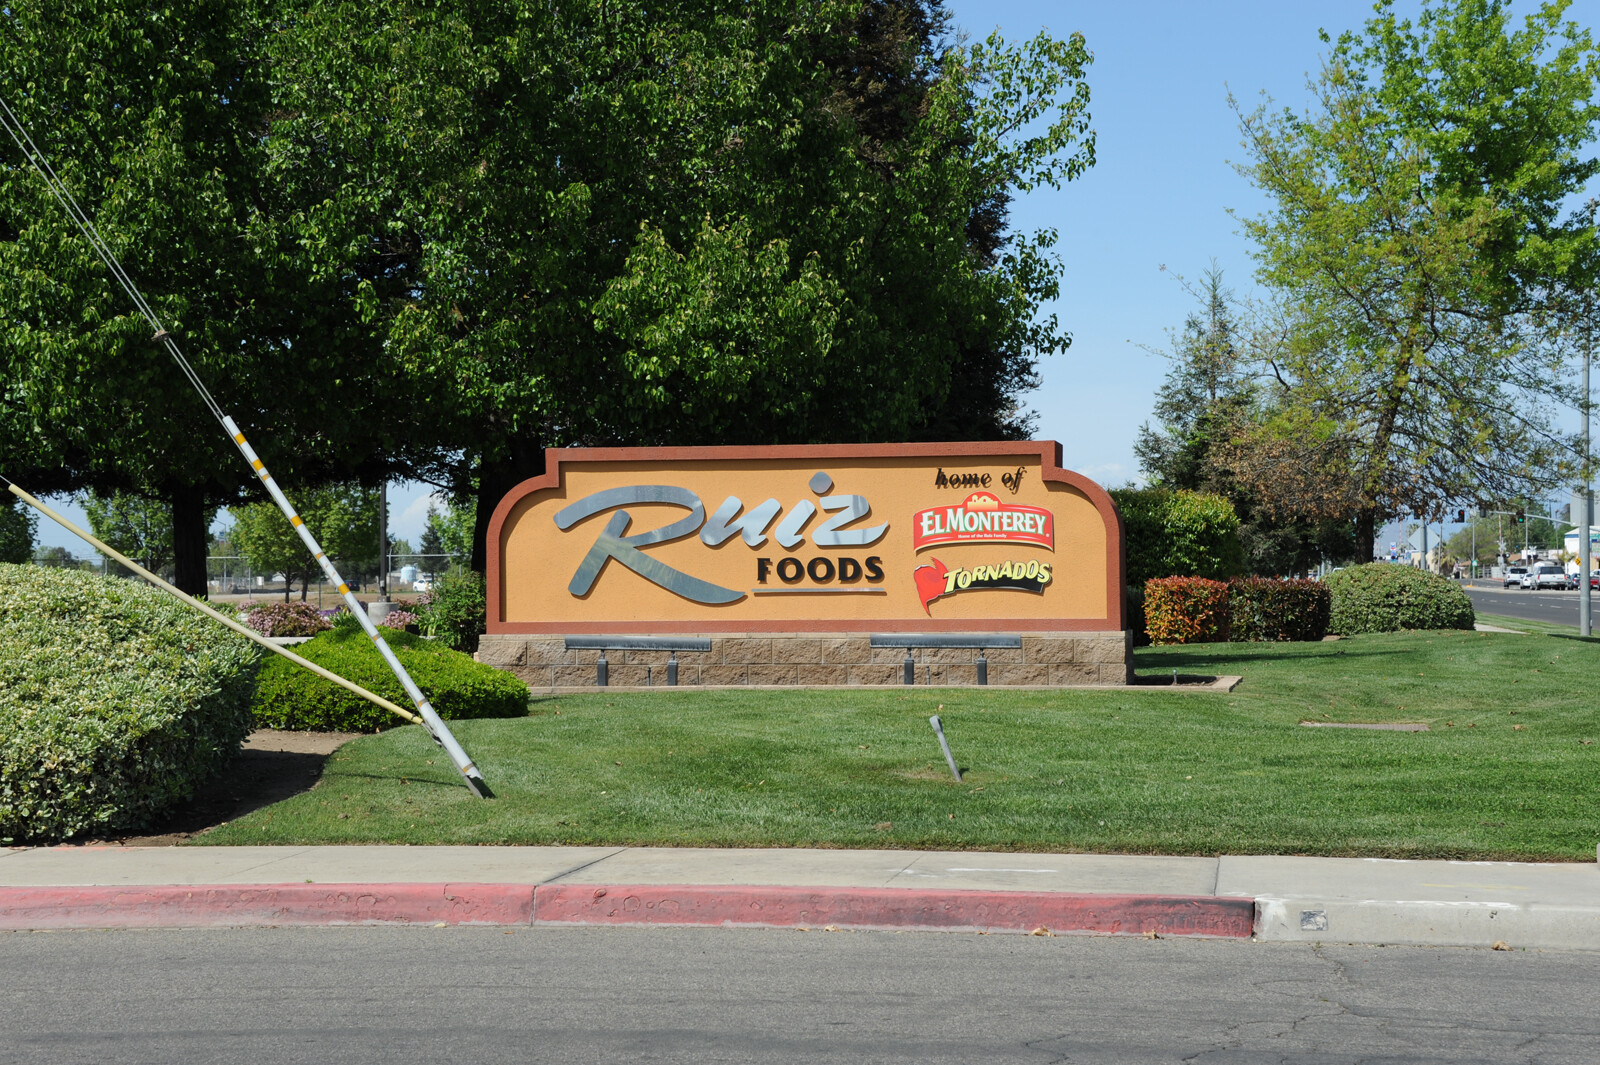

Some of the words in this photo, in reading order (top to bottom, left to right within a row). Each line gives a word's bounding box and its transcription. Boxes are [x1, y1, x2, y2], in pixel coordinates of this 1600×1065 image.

[934, 467, 991, 488] home
[1001, 466, 1026, 493] of
[553, 471, 889, 604] Ruiz
[920, 510, 944, 538] EL
[943, 507, 1047, 536] MONTEREY
[757, 556, 884, 581] FOODS
[943, 559, 1051, 593] TORNADOS
